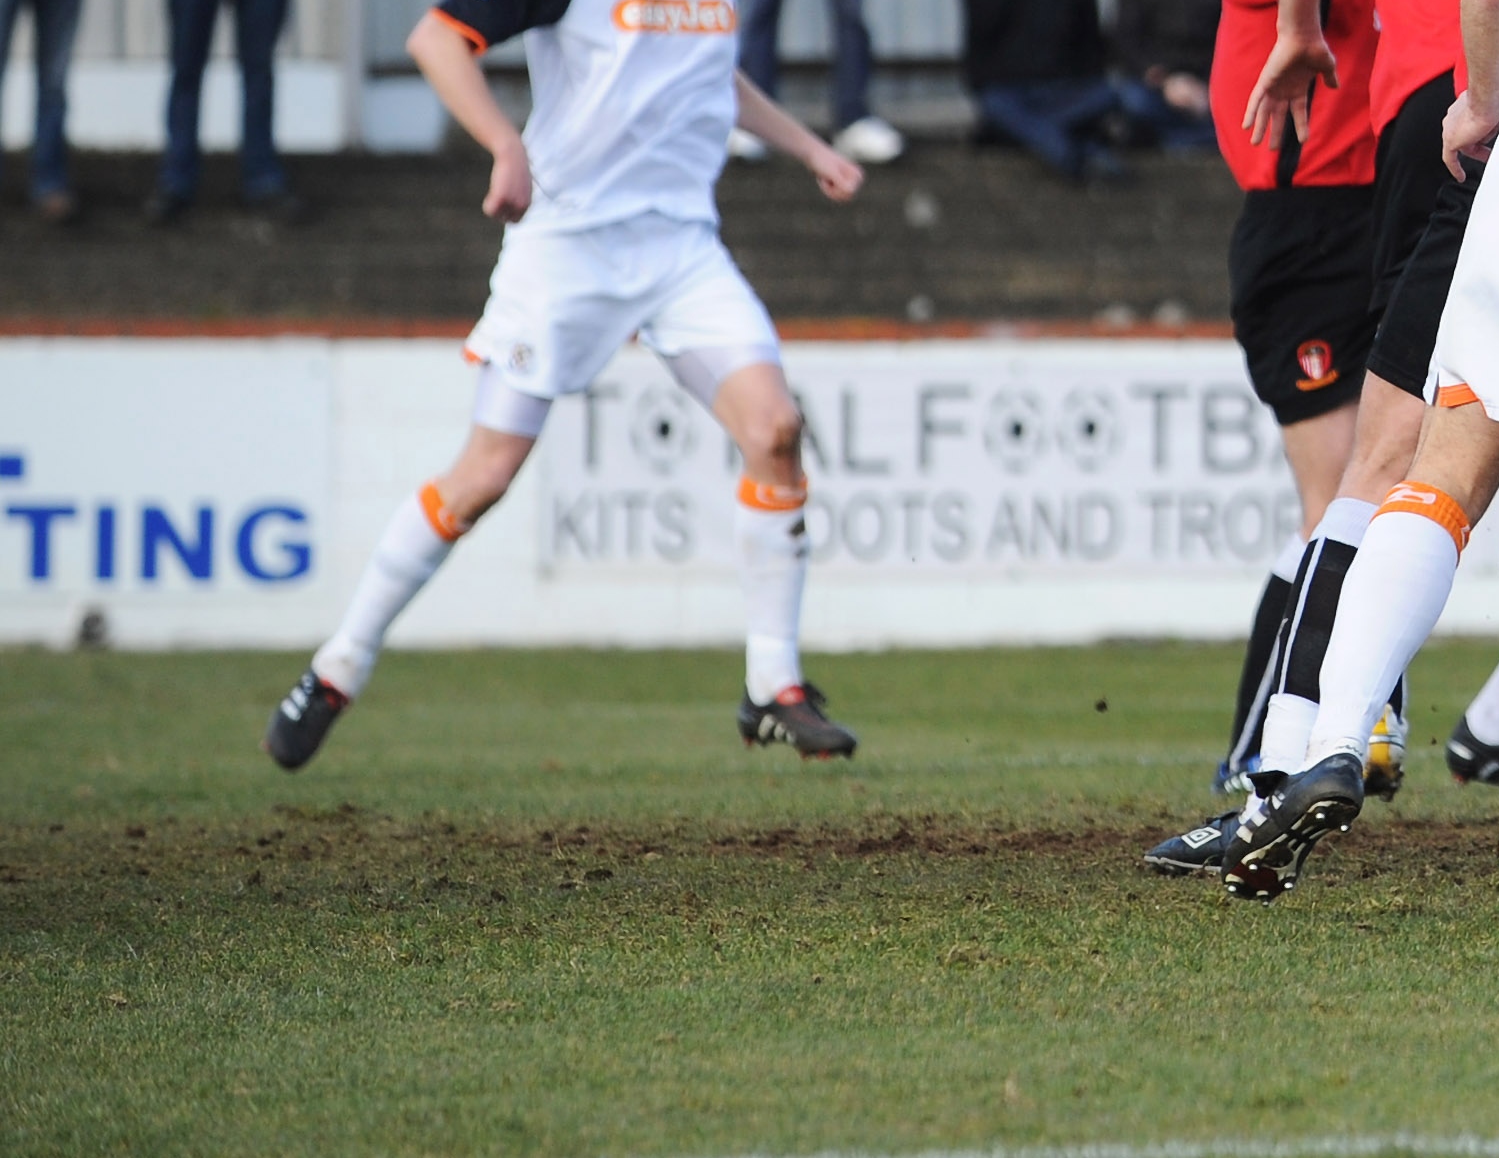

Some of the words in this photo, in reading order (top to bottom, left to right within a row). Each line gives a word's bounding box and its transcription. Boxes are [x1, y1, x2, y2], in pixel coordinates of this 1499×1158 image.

[918, 383, 1284, 475] FOOTB
[6, 507, 312, 580] TING
[551, 494, 690, 562] KITS
[985, 492, 1122, 562] AND
